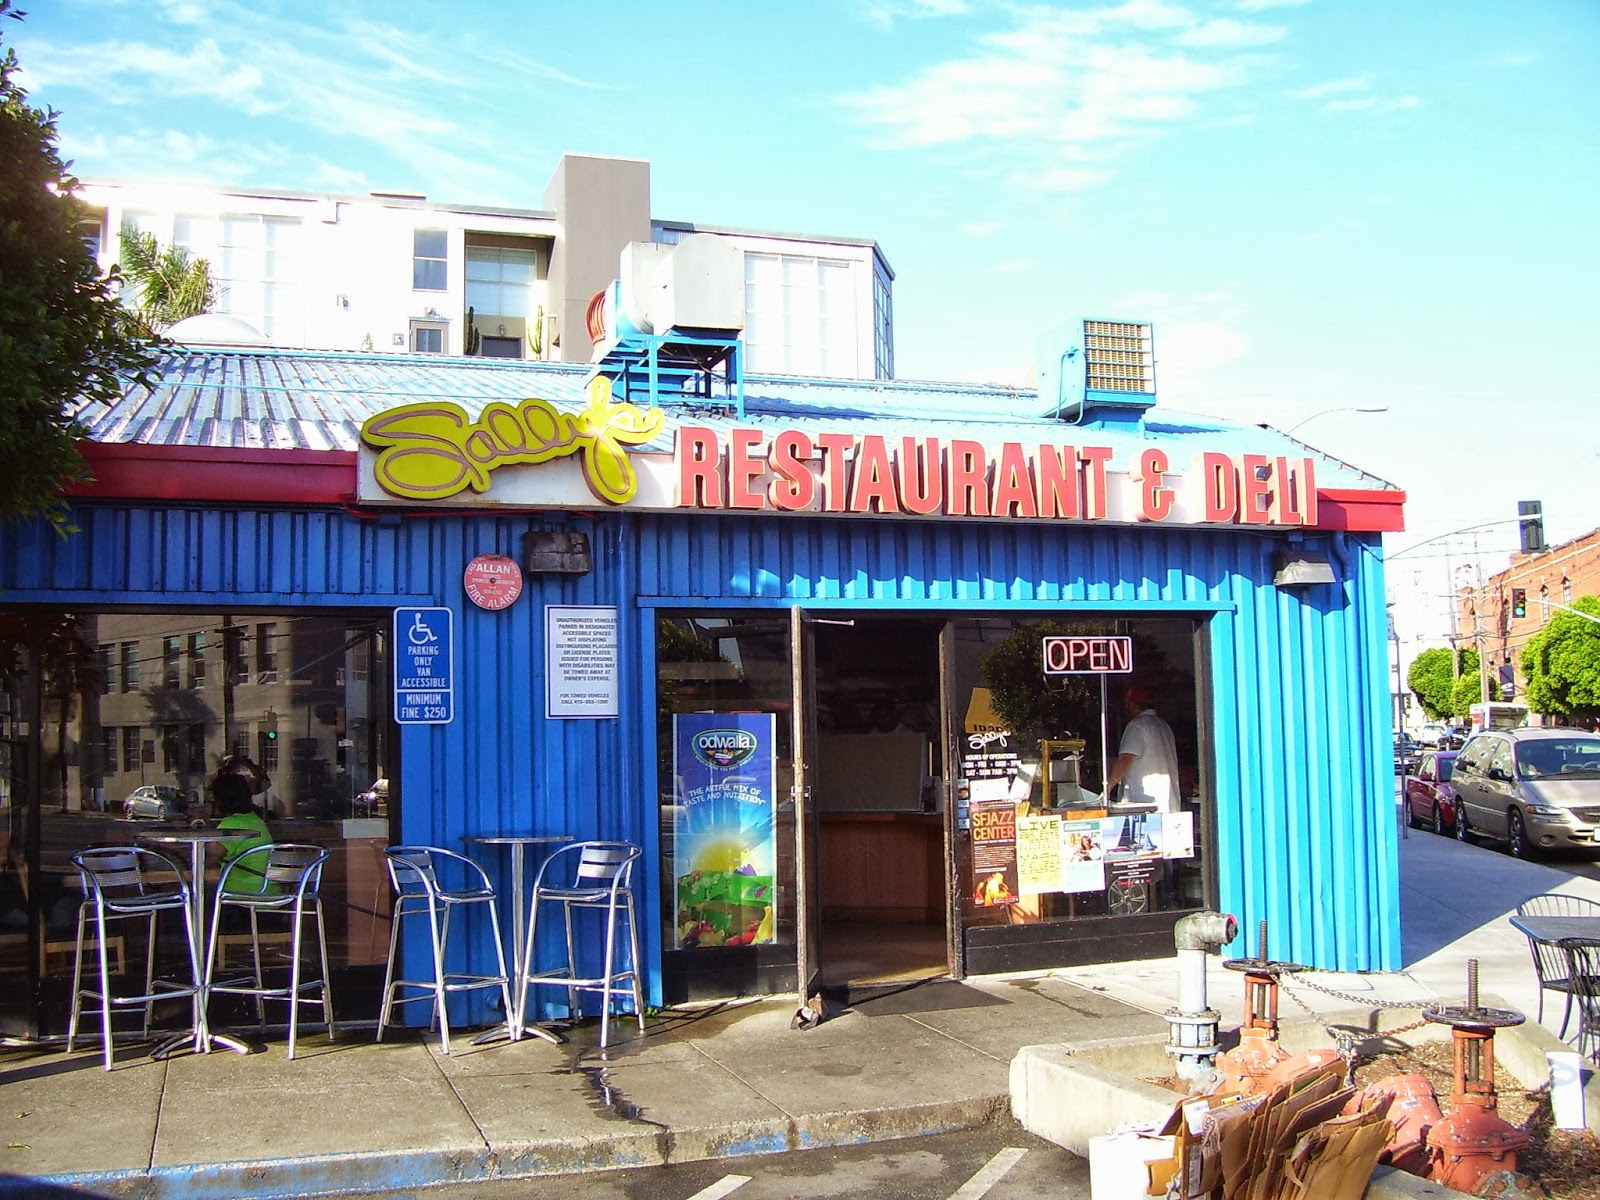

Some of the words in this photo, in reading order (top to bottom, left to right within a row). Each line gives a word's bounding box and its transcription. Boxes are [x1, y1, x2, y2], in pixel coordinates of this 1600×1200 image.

[675, 426, 1114, 519] RESTAURANT
[1132, 447, 1176, 522] &
[1202, 451, 1319, 526] DELI
[475, 563, 511, 574] ALLAN
[467, 583, 486, 605] FIRE
[487, 586, 519, 608] ALARM
[407, 645, 439, 655] PARKING
[1047, 640, 1129, 671] OPEN
[414, 656, 433, 666] ONLY
[416, 666, 431, 676] VAN
[401, 677, 446, 687] ACCESSIBLE
[406, 693, 442, 705] MINIMUM
[401, 707, 420, 718] FINE
[424, 706, 447, 718] $250
[698, 734, 751, 749] odwalla
[688, 786, 704, 798] THE
[705, 784, 732, 793] ARTFUL
[733, 784, 749, 793] MIX
[750, 787, 762, 796] OF
[683, 794, 706, 808] TASTE
[706, 792, 721, 800] AND
[972, 810, 1015, 827] SFJAZZ
[1018, 820, 1059, 831] LIVE
[973, 826, 1015, 841] CENTER
